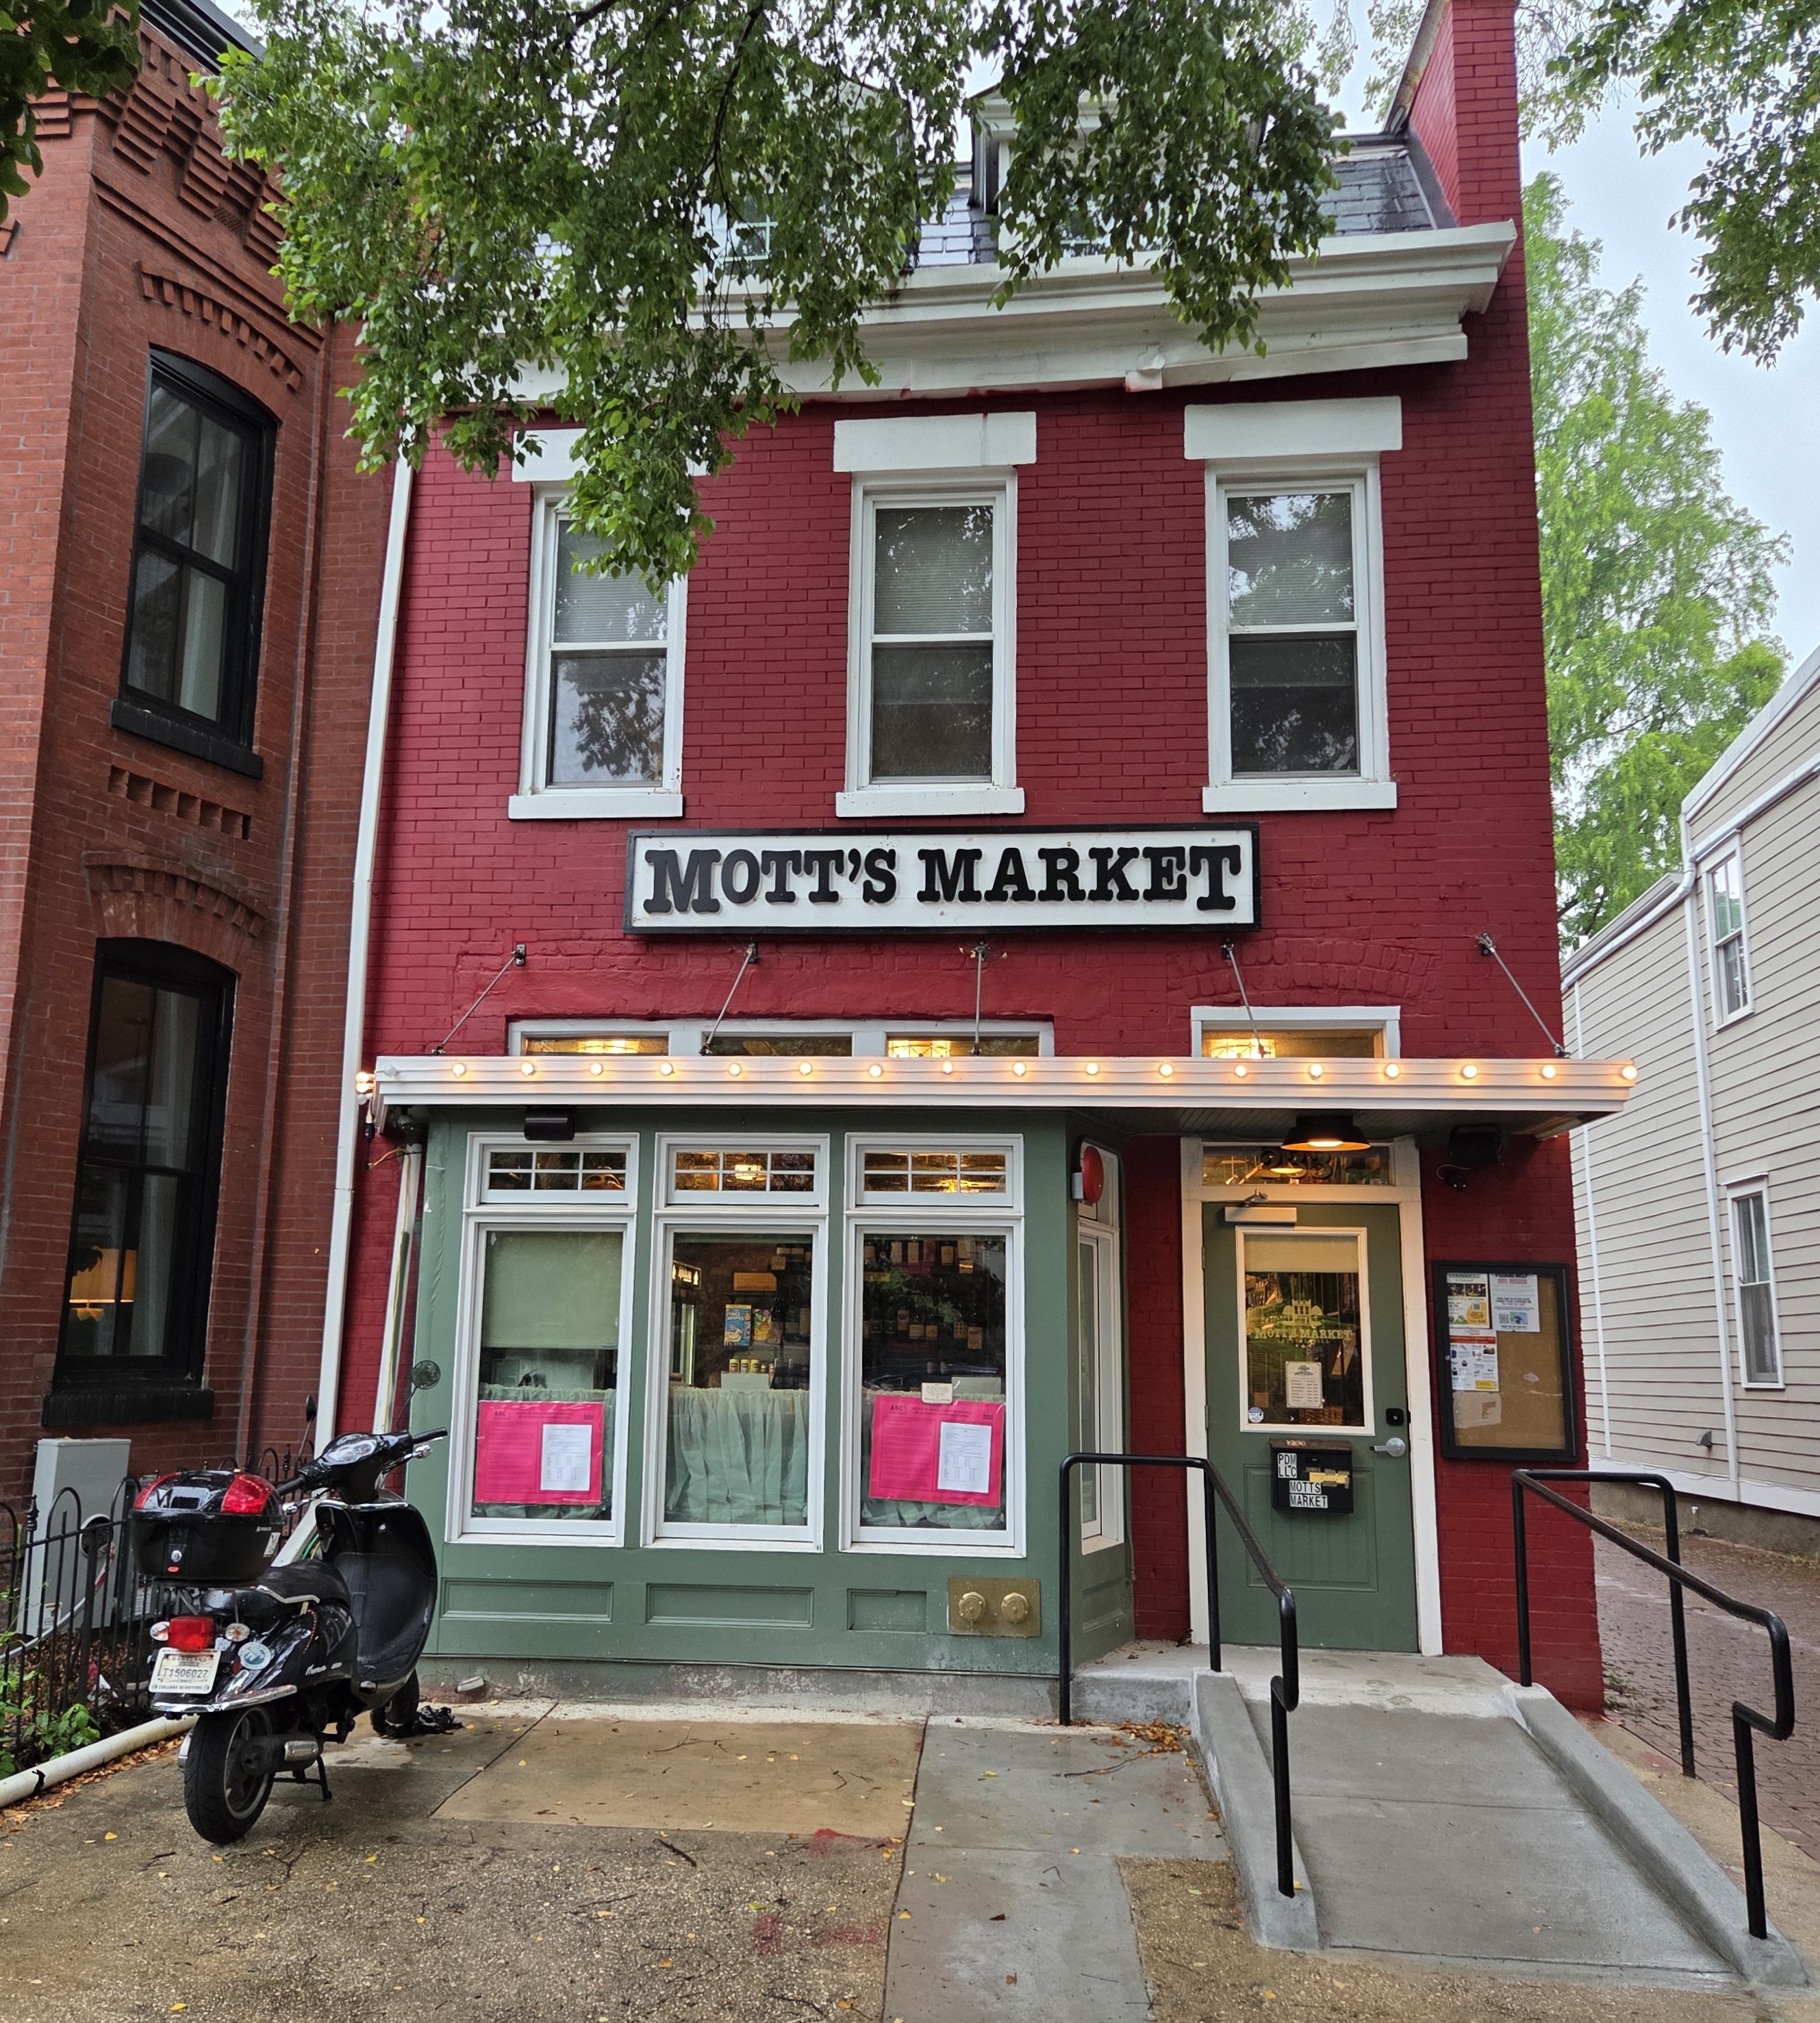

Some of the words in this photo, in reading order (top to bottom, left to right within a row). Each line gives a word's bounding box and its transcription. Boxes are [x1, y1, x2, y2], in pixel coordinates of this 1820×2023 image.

[643, 848, 897, 914] MOTT'S
[916, 845, 1241, 912] MARKET
[1299, 1329, 1353, 1340] MARKET
[1278, 1454, 1296, 1465] PDM
[1278, 1466, 1296, 1477] LLC
[1290, 1481, 1321, 1493] MOTTS
[1290, 1495, 1327, 1507] MARKET
[163, 1668, 209, 1679] T1506027
